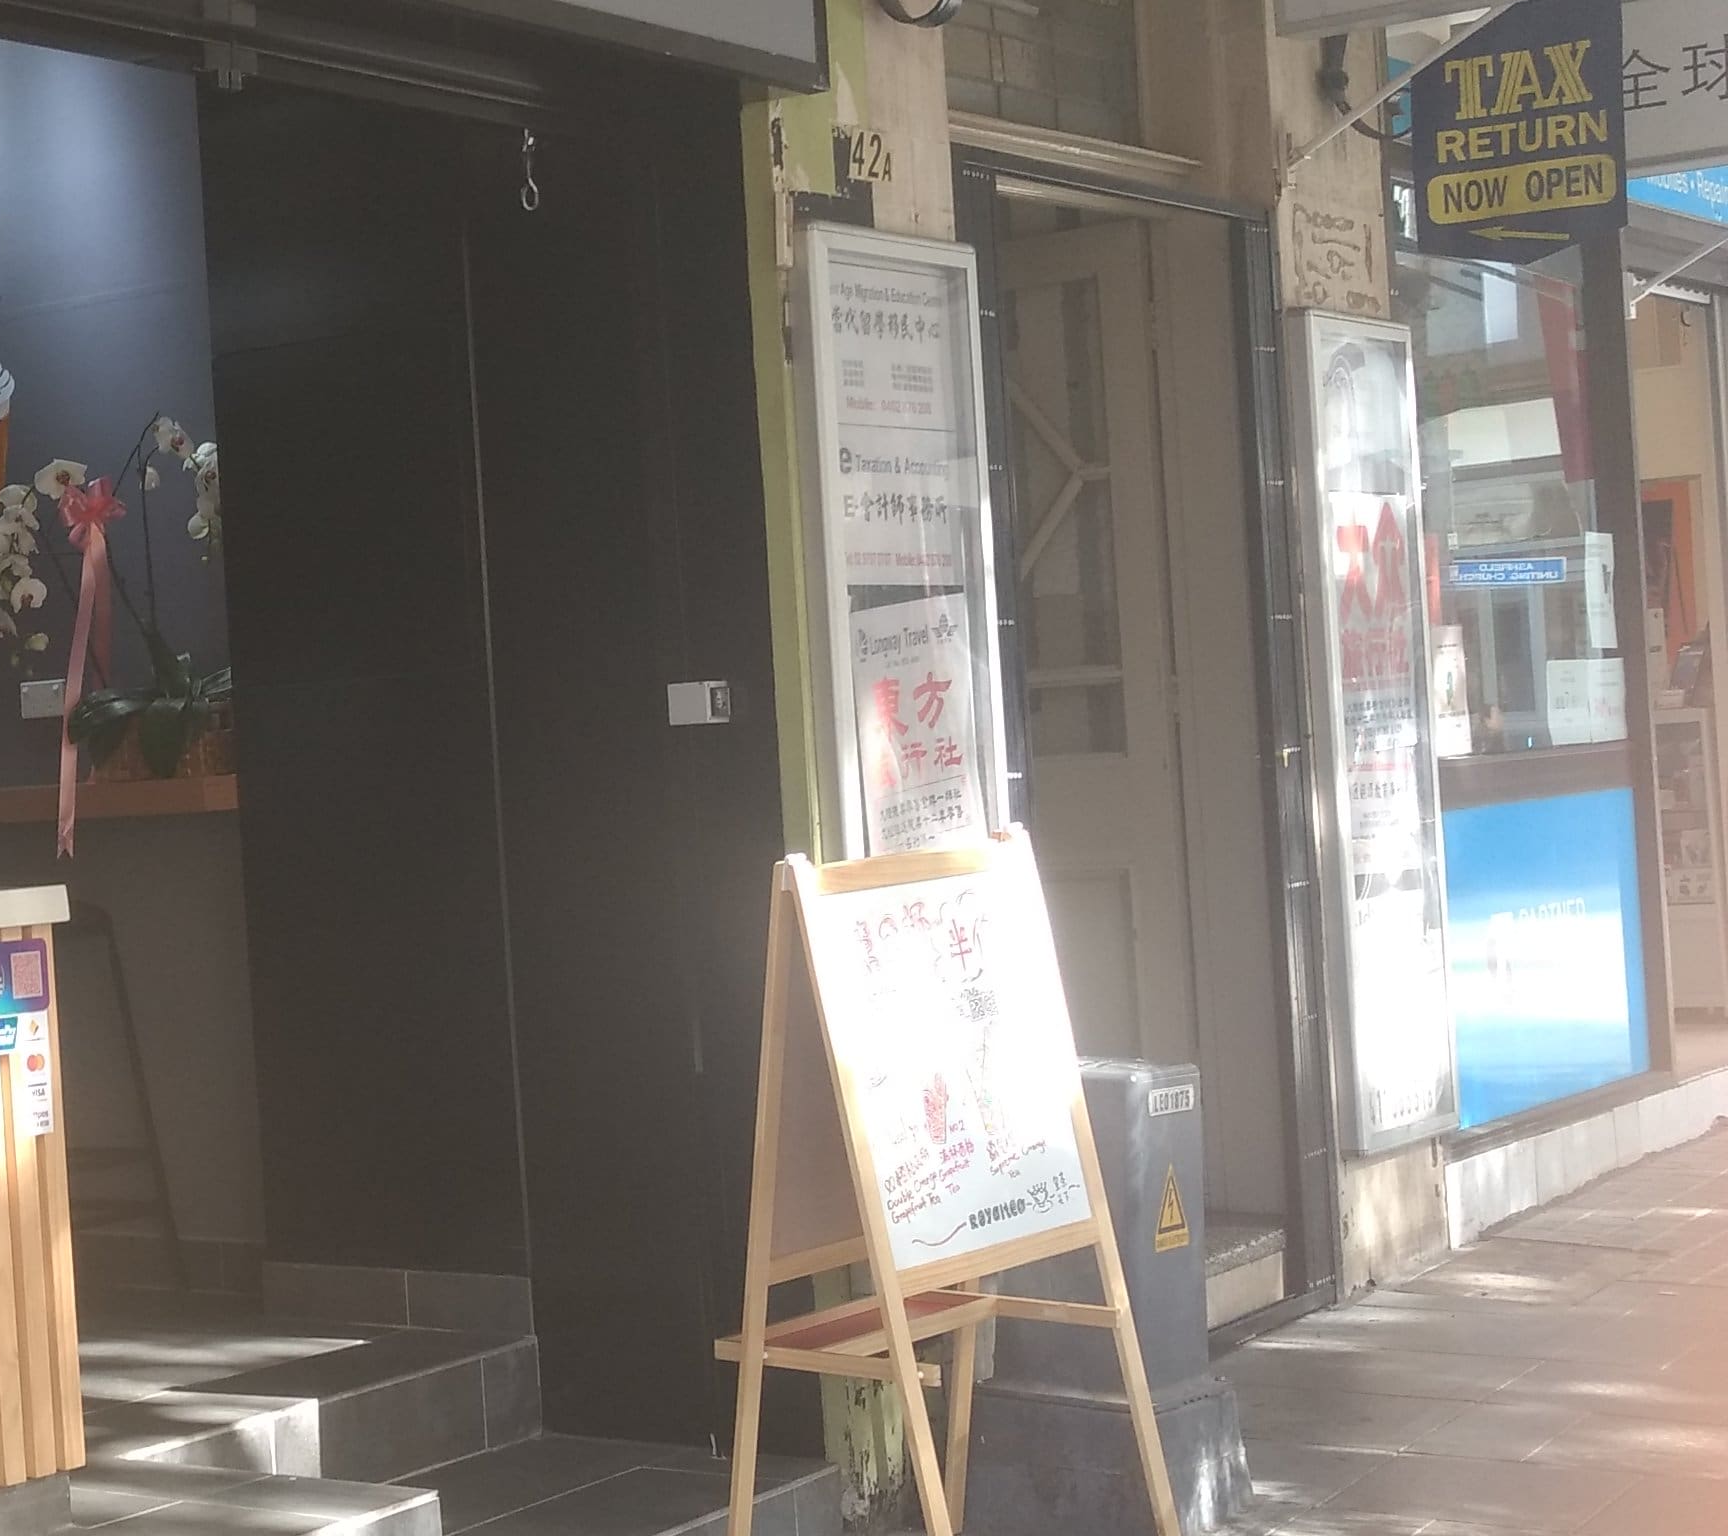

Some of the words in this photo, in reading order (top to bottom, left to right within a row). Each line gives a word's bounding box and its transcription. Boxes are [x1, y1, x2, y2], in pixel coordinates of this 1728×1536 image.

[1445, 40, 1592, 120] TAX
[852, 131, 892, 182] 42A
[1437, 110, 1608, 163] RETURN
[1444, 176, 1507, 214] NOW
[1525, 163, 1603, 201] OPEN
